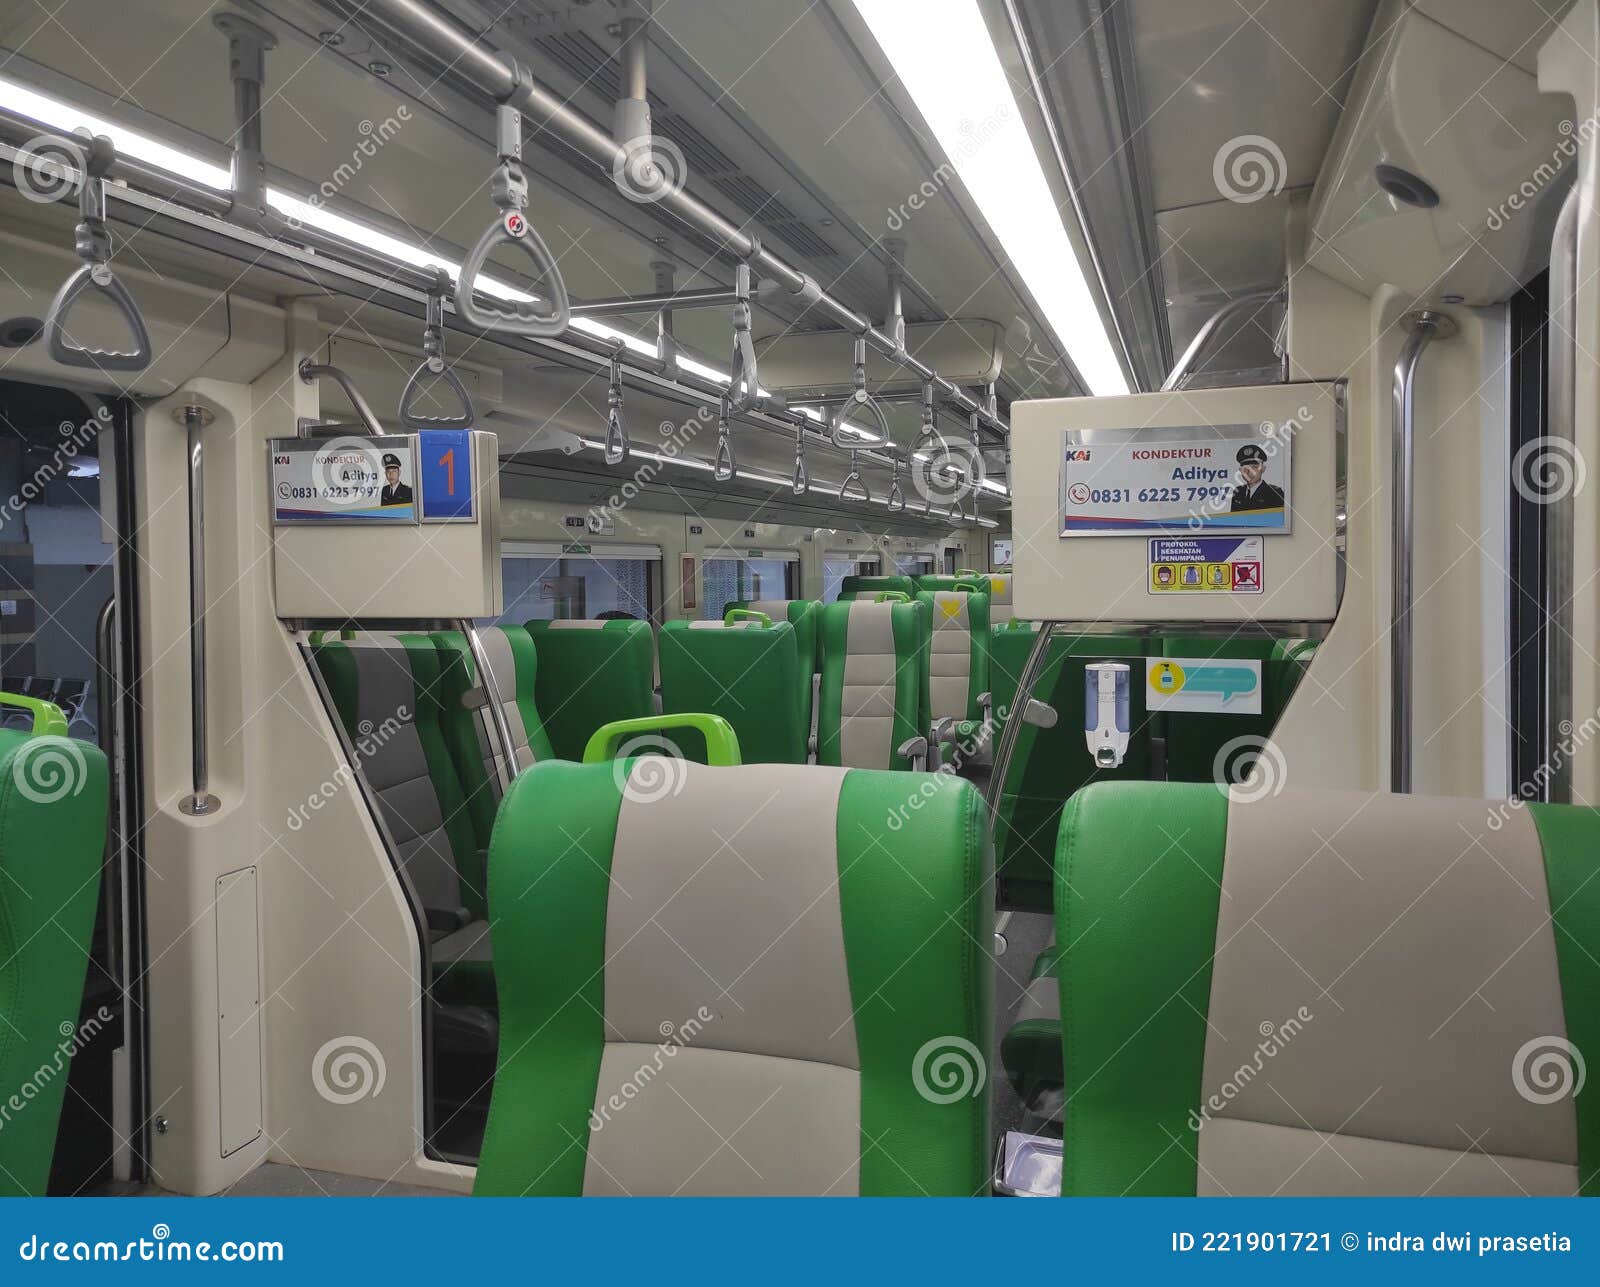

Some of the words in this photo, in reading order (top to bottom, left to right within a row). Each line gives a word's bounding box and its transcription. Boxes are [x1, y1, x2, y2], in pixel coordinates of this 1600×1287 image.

[314, 456, 366, 465] KONDEKTUR
[1132, 448, 1212, 460] KONDEKTUR
[342, 469, 378, 482] Aditya
[439, 448, 454, 496] 1
[1171, 466, 1228, 483] Aditya
[292, 487, 317, 498] 0831
[322, 486, 349, 498] 6225
[353, 486, 380, 498] 7997
[1091, 488, 1130, 503] 0831
[1137, 487, 1180, 503] 6225
[1186, 486, 1231, 502] 7997
